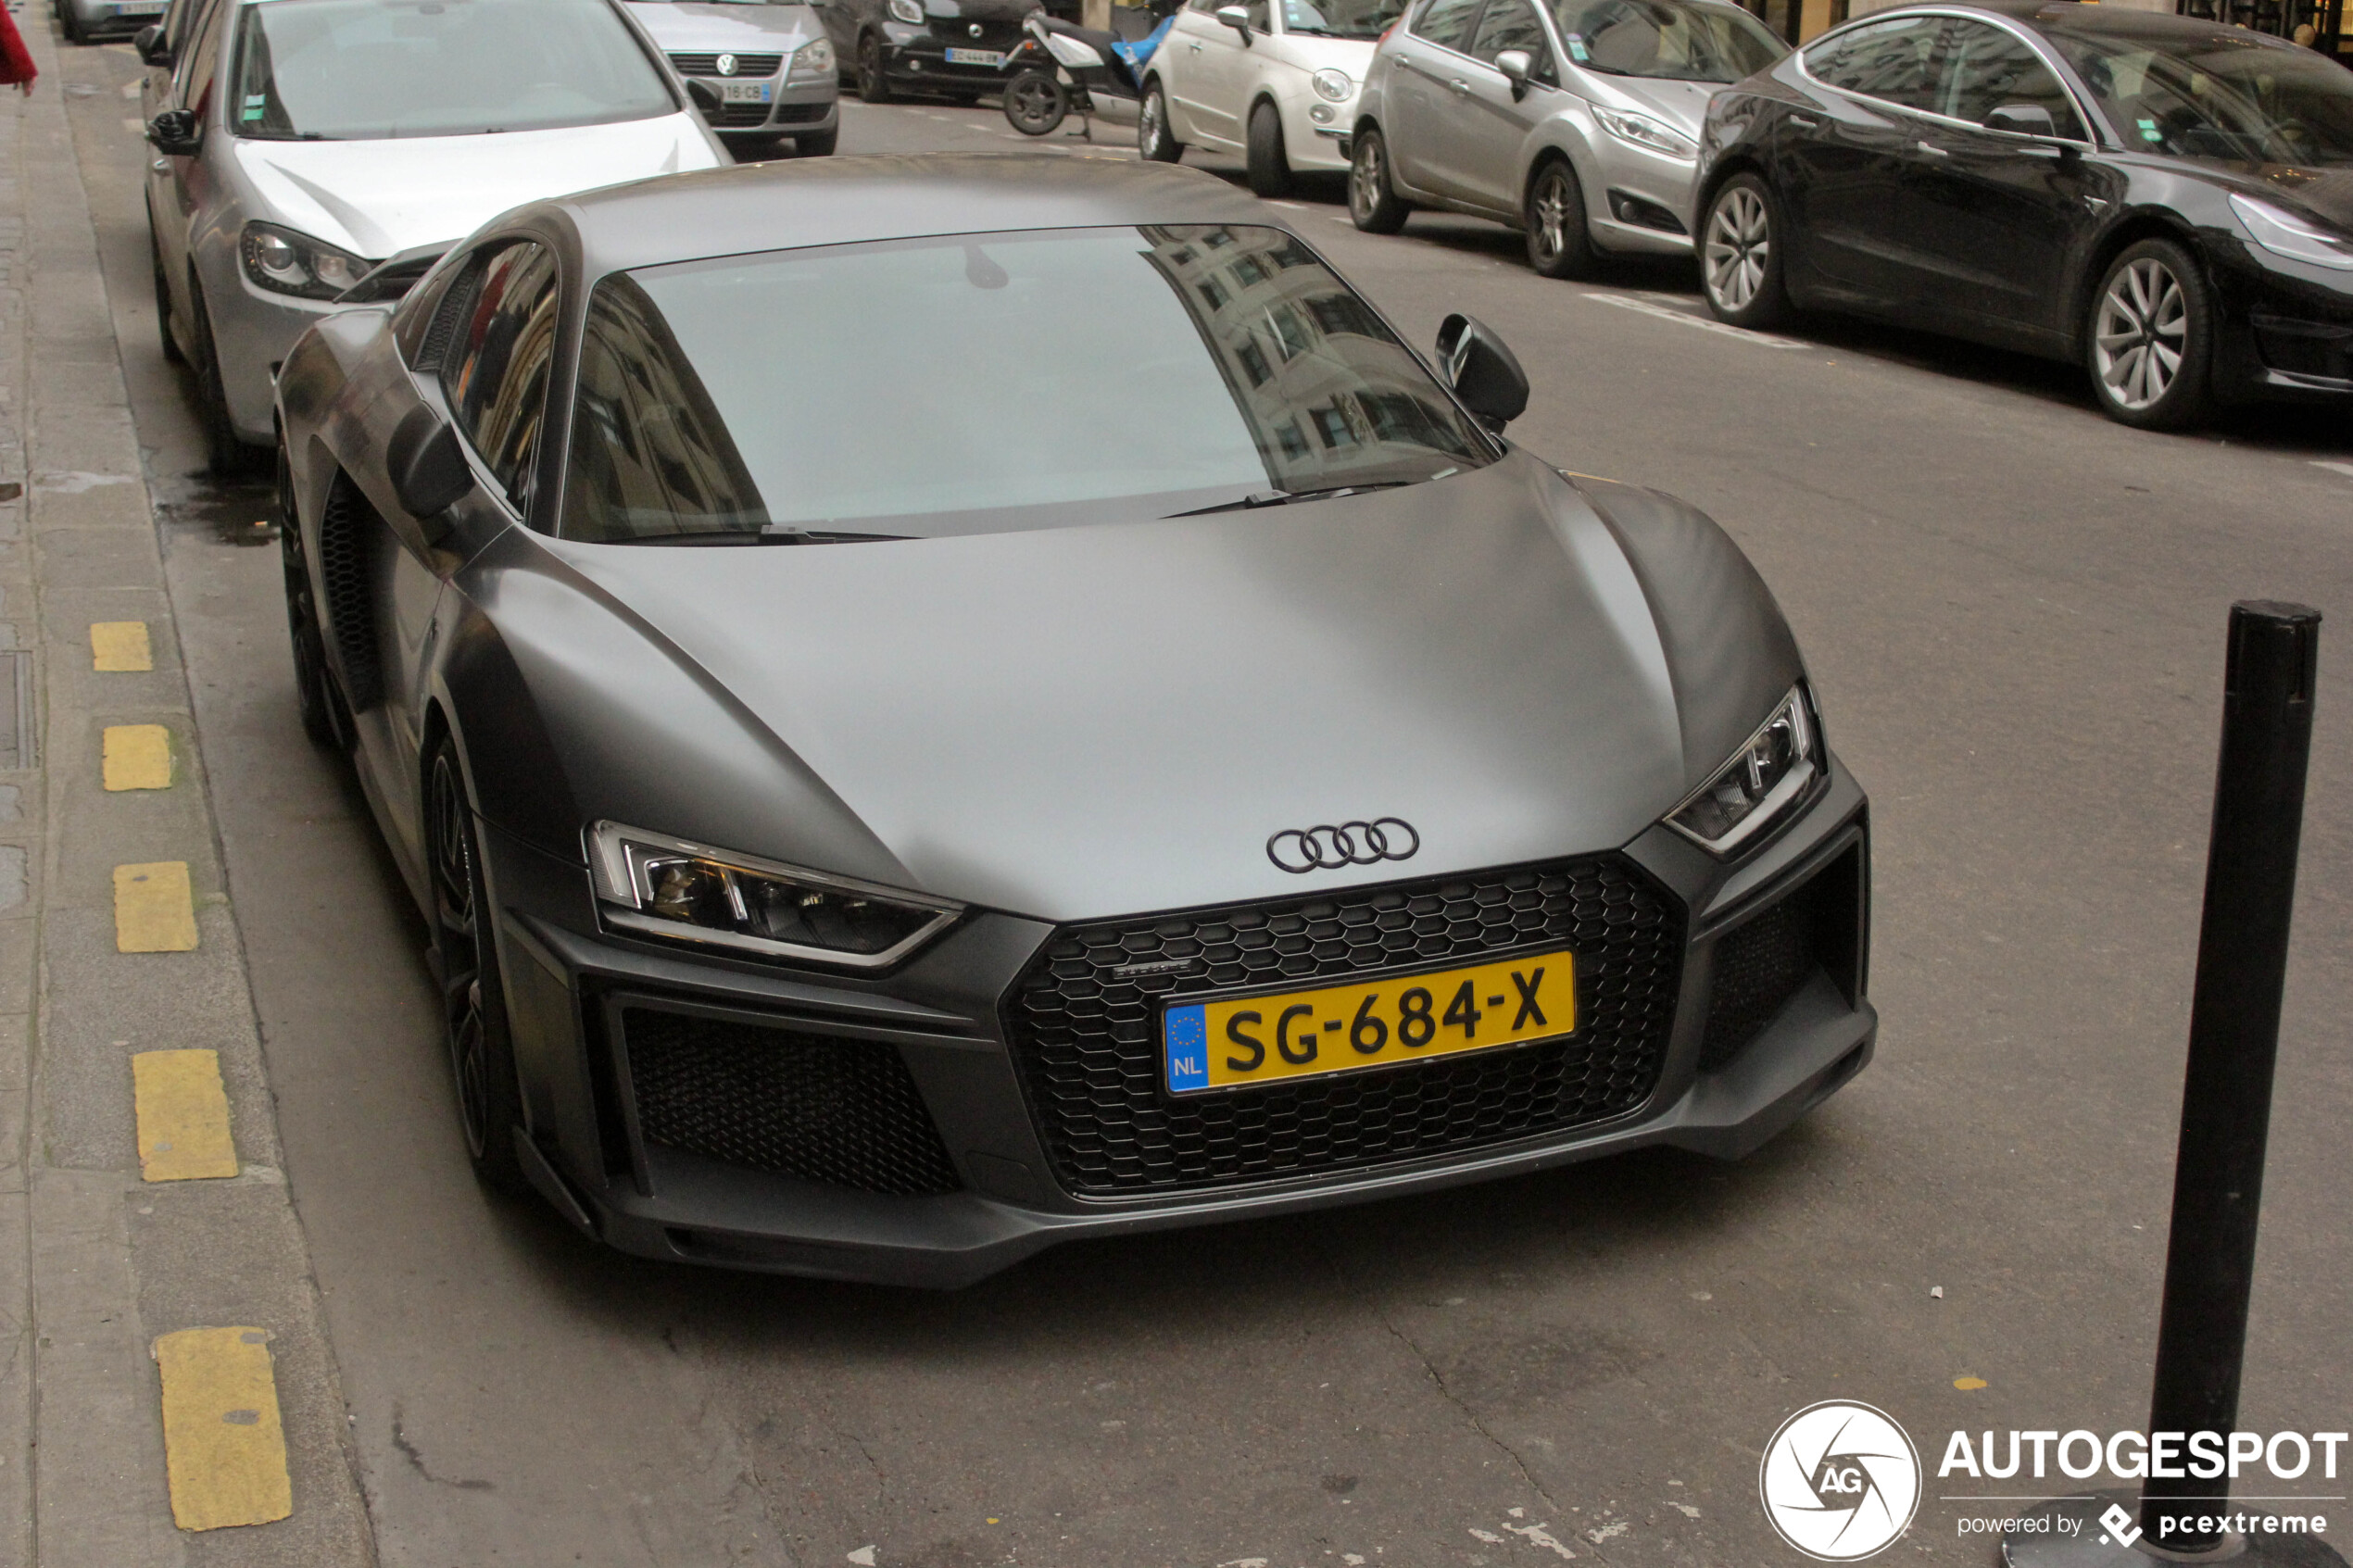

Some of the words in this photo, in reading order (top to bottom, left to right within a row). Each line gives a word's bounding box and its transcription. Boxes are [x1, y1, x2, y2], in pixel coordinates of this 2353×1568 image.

[726, 85, 760, 98] 16-CB
[1226, 967, 1547, 1072] SG-684-X
[1175, 1057, 1202, 1076] NL
